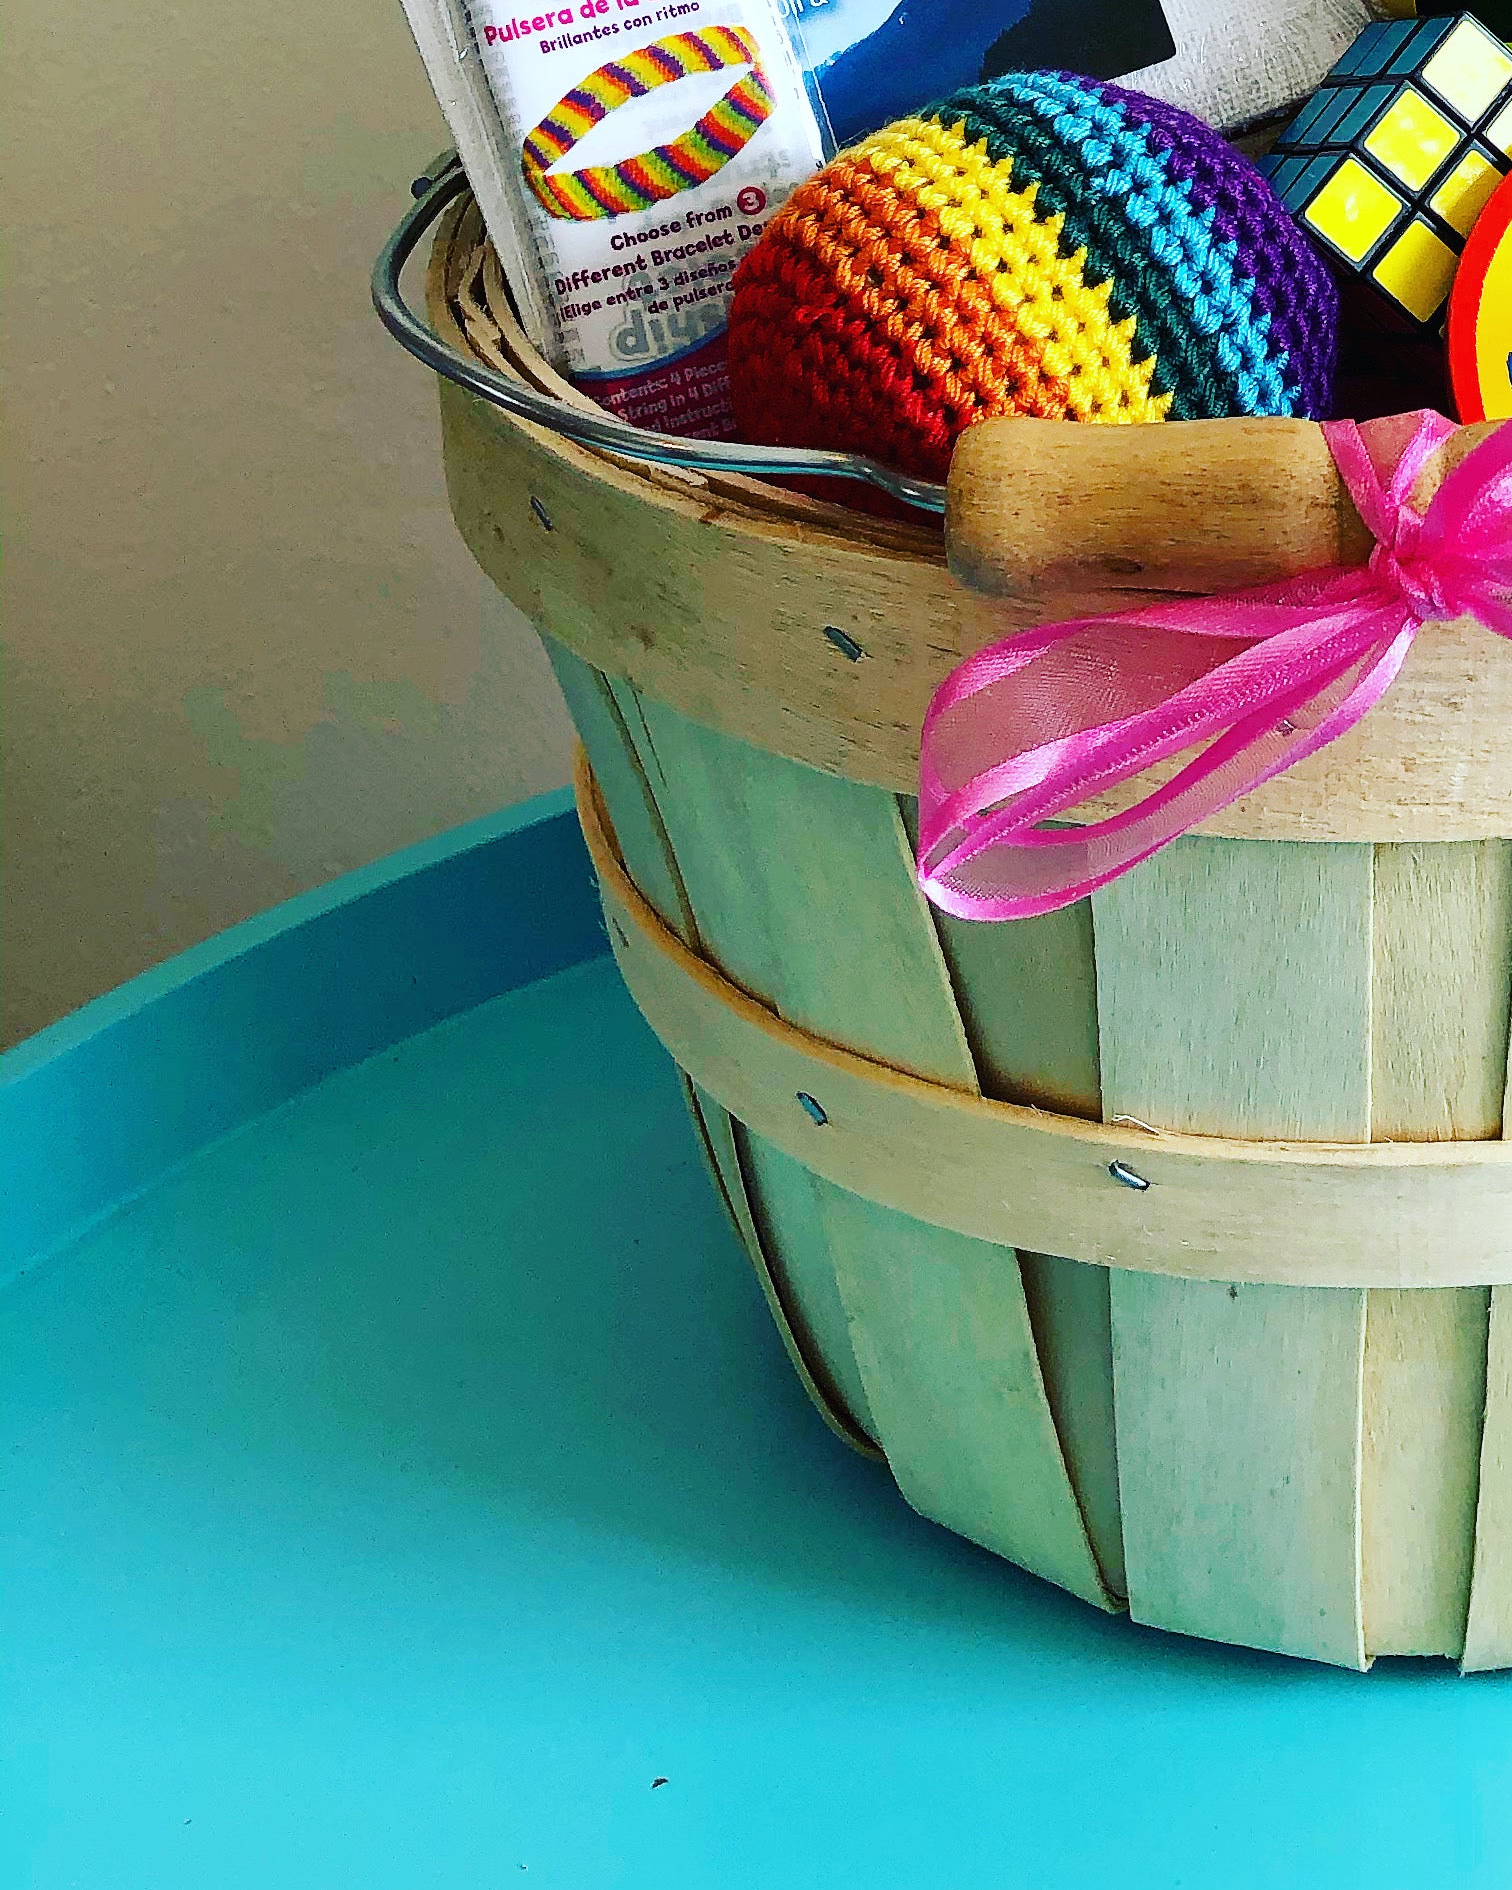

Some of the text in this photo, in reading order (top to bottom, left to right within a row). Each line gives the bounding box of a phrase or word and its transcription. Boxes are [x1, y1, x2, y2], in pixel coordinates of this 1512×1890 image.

[483, 7, 574, 46] Pulsera
[540, 0, 700, 54] Brillantes con ritmo
[610, 191, 760, 251] Choose from 3
[554, 253, 647, 296] Different
[650, 229, 735, 267] Bracelet
[606, 283, 653, 306] entre
[657, 276, 670, 291] 3
[674, 259, 737, 287] diseños
[647, 300, 669, 314] de
